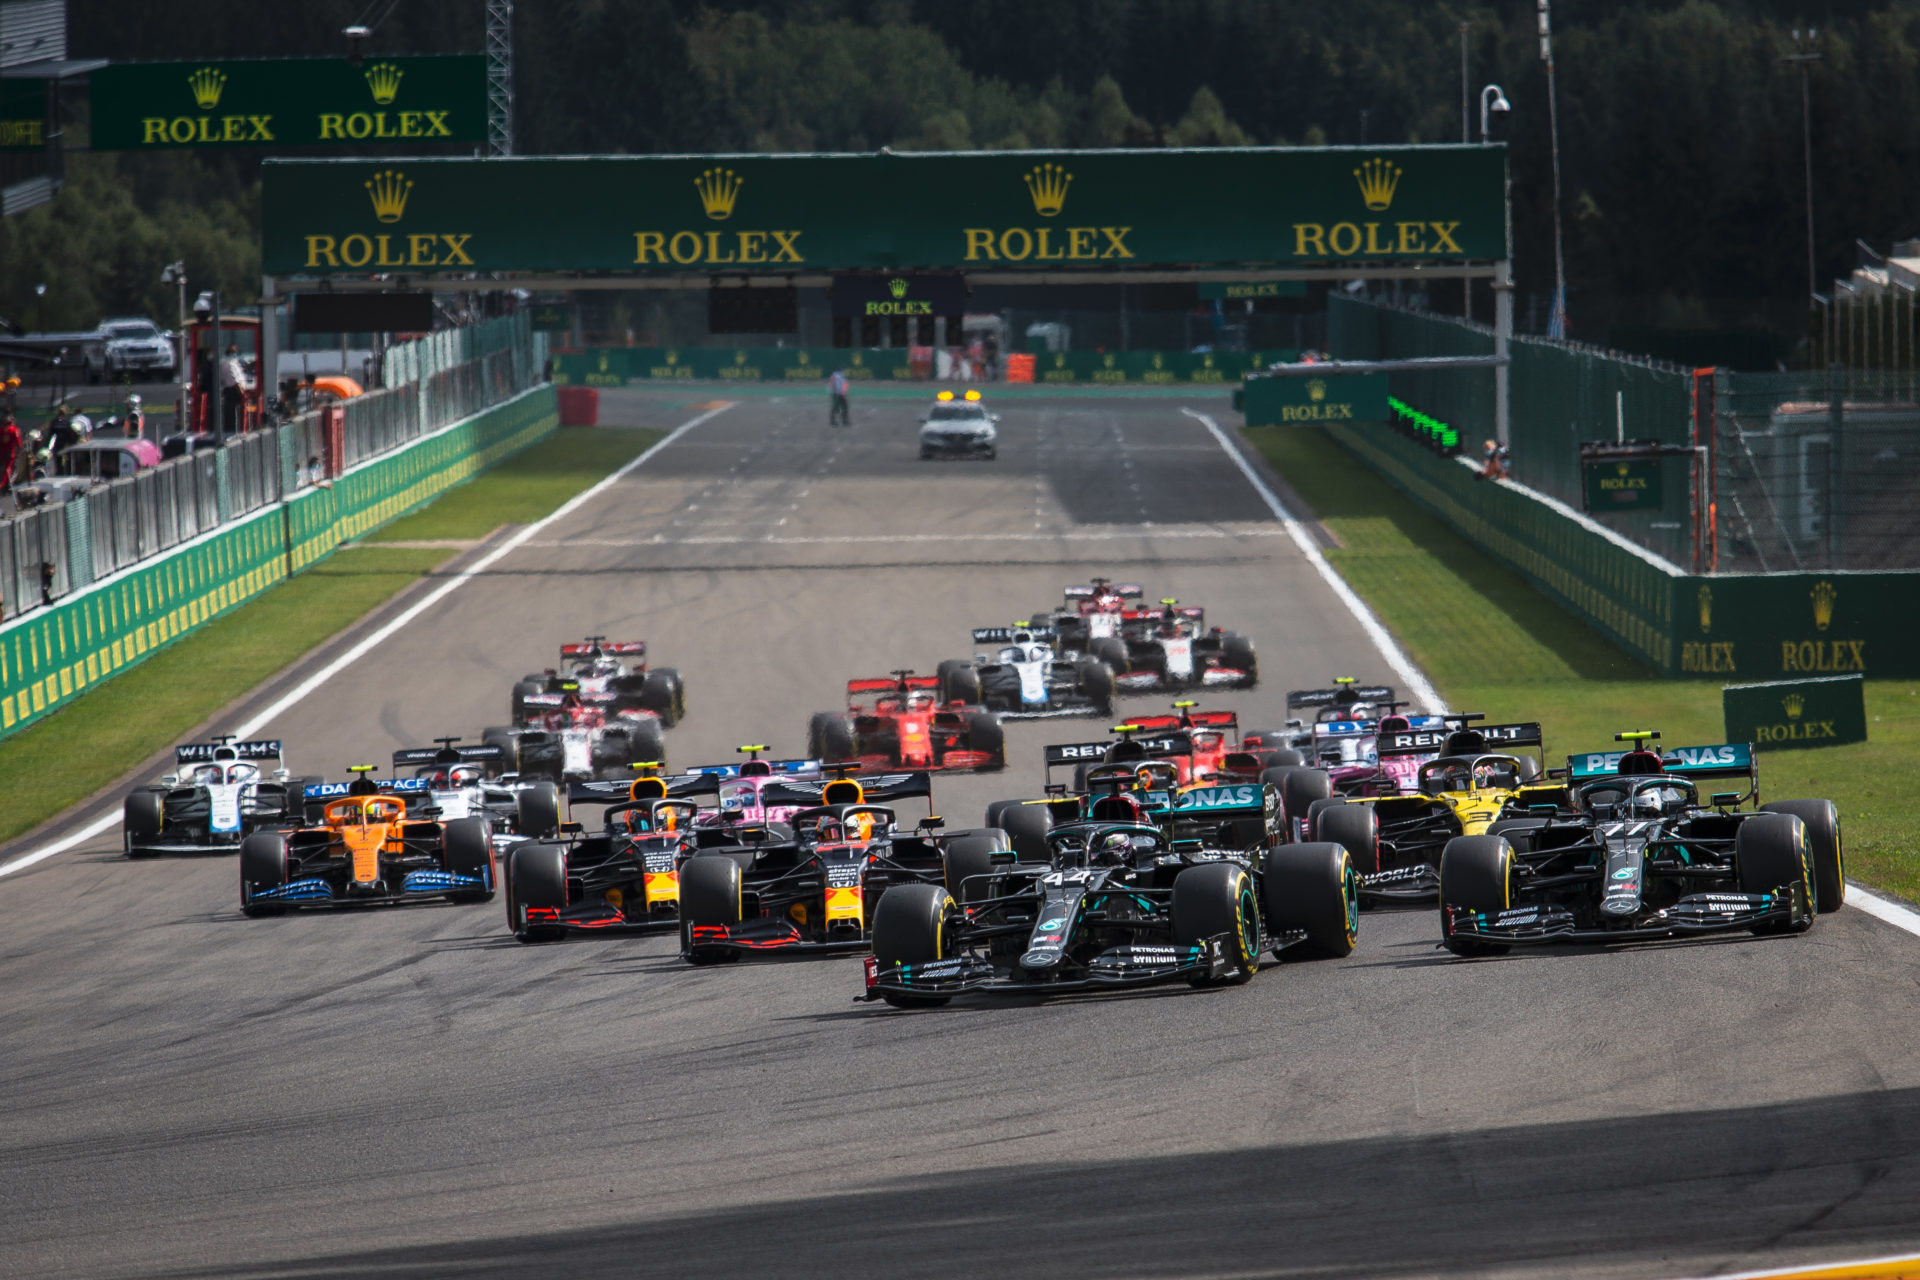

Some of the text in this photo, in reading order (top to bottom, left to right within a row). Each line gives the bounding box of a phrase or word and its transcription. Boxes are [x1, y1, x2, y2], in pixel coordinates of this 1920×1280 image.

[142, 114, 275, 144] ROLEX
[319, 111, 452, 139] ROLEX
[304, 234, 475, 268] ROLEX
[633, 231, 805, 264] ROLEX
[964, 227, 1135, 261] ROLEX
[1293, 221, 1463, 256] ROLEX
[865, 302, 933, 315] ROLEX
[1283, 404, 1352, 421] ROLEX
[1682, 642, 1736, 672] ROLEX
[1782, 641, 1866, 671] ROLEX
[1756, 721, 1836, 743] ROLEX
[1042, 871, 1091, 886] 44
[1364, 864, 1425, 886] WORLD
[1498, 906, 1538, 917] PETRONAS
[923, 958, 962, 969] PETRONAS
